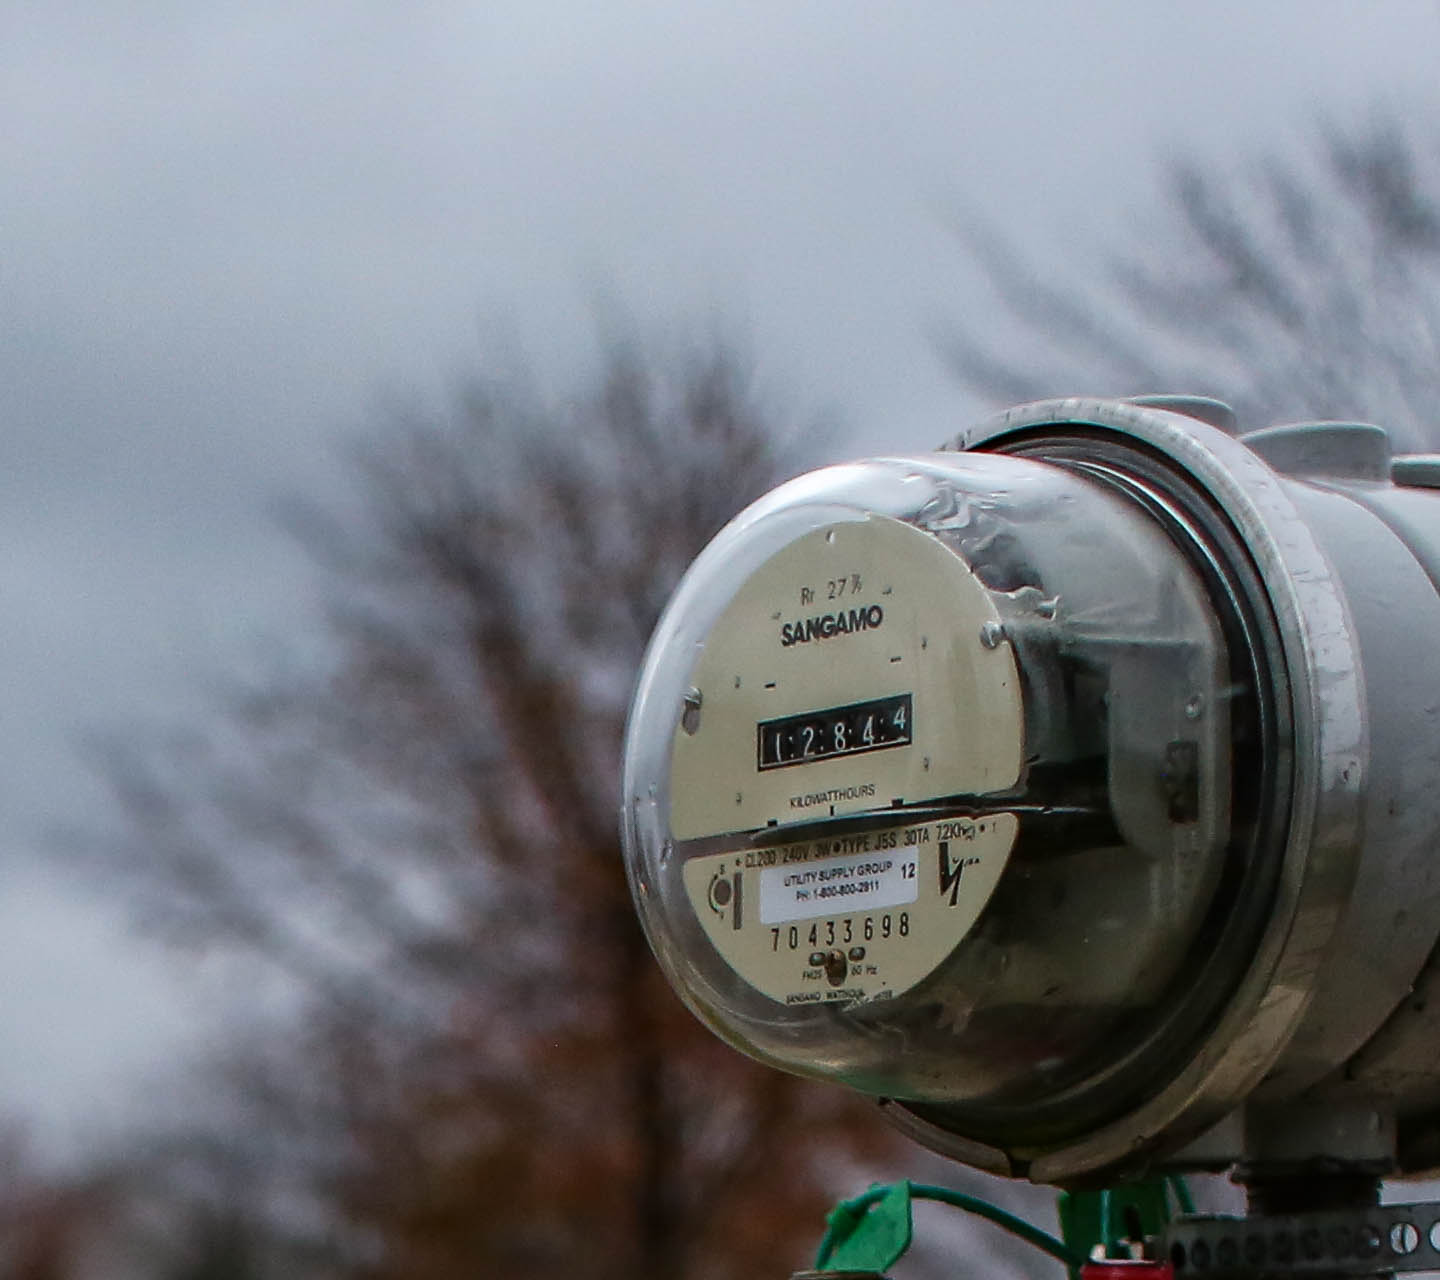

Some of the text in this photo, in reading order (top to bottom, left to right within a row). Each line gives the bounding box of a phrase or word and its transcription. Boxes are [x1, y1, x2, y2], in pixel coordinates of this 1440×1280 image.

[781, 605, 883, 647] SANGAMO
[790, 784, 876, 808] KILOWATTHOURS
[784, 860, 893, 887] UTILITY SUPPLY GROUP
[901, 862, 916, 879] 12
[771, 912, 910, 951] 70433698
